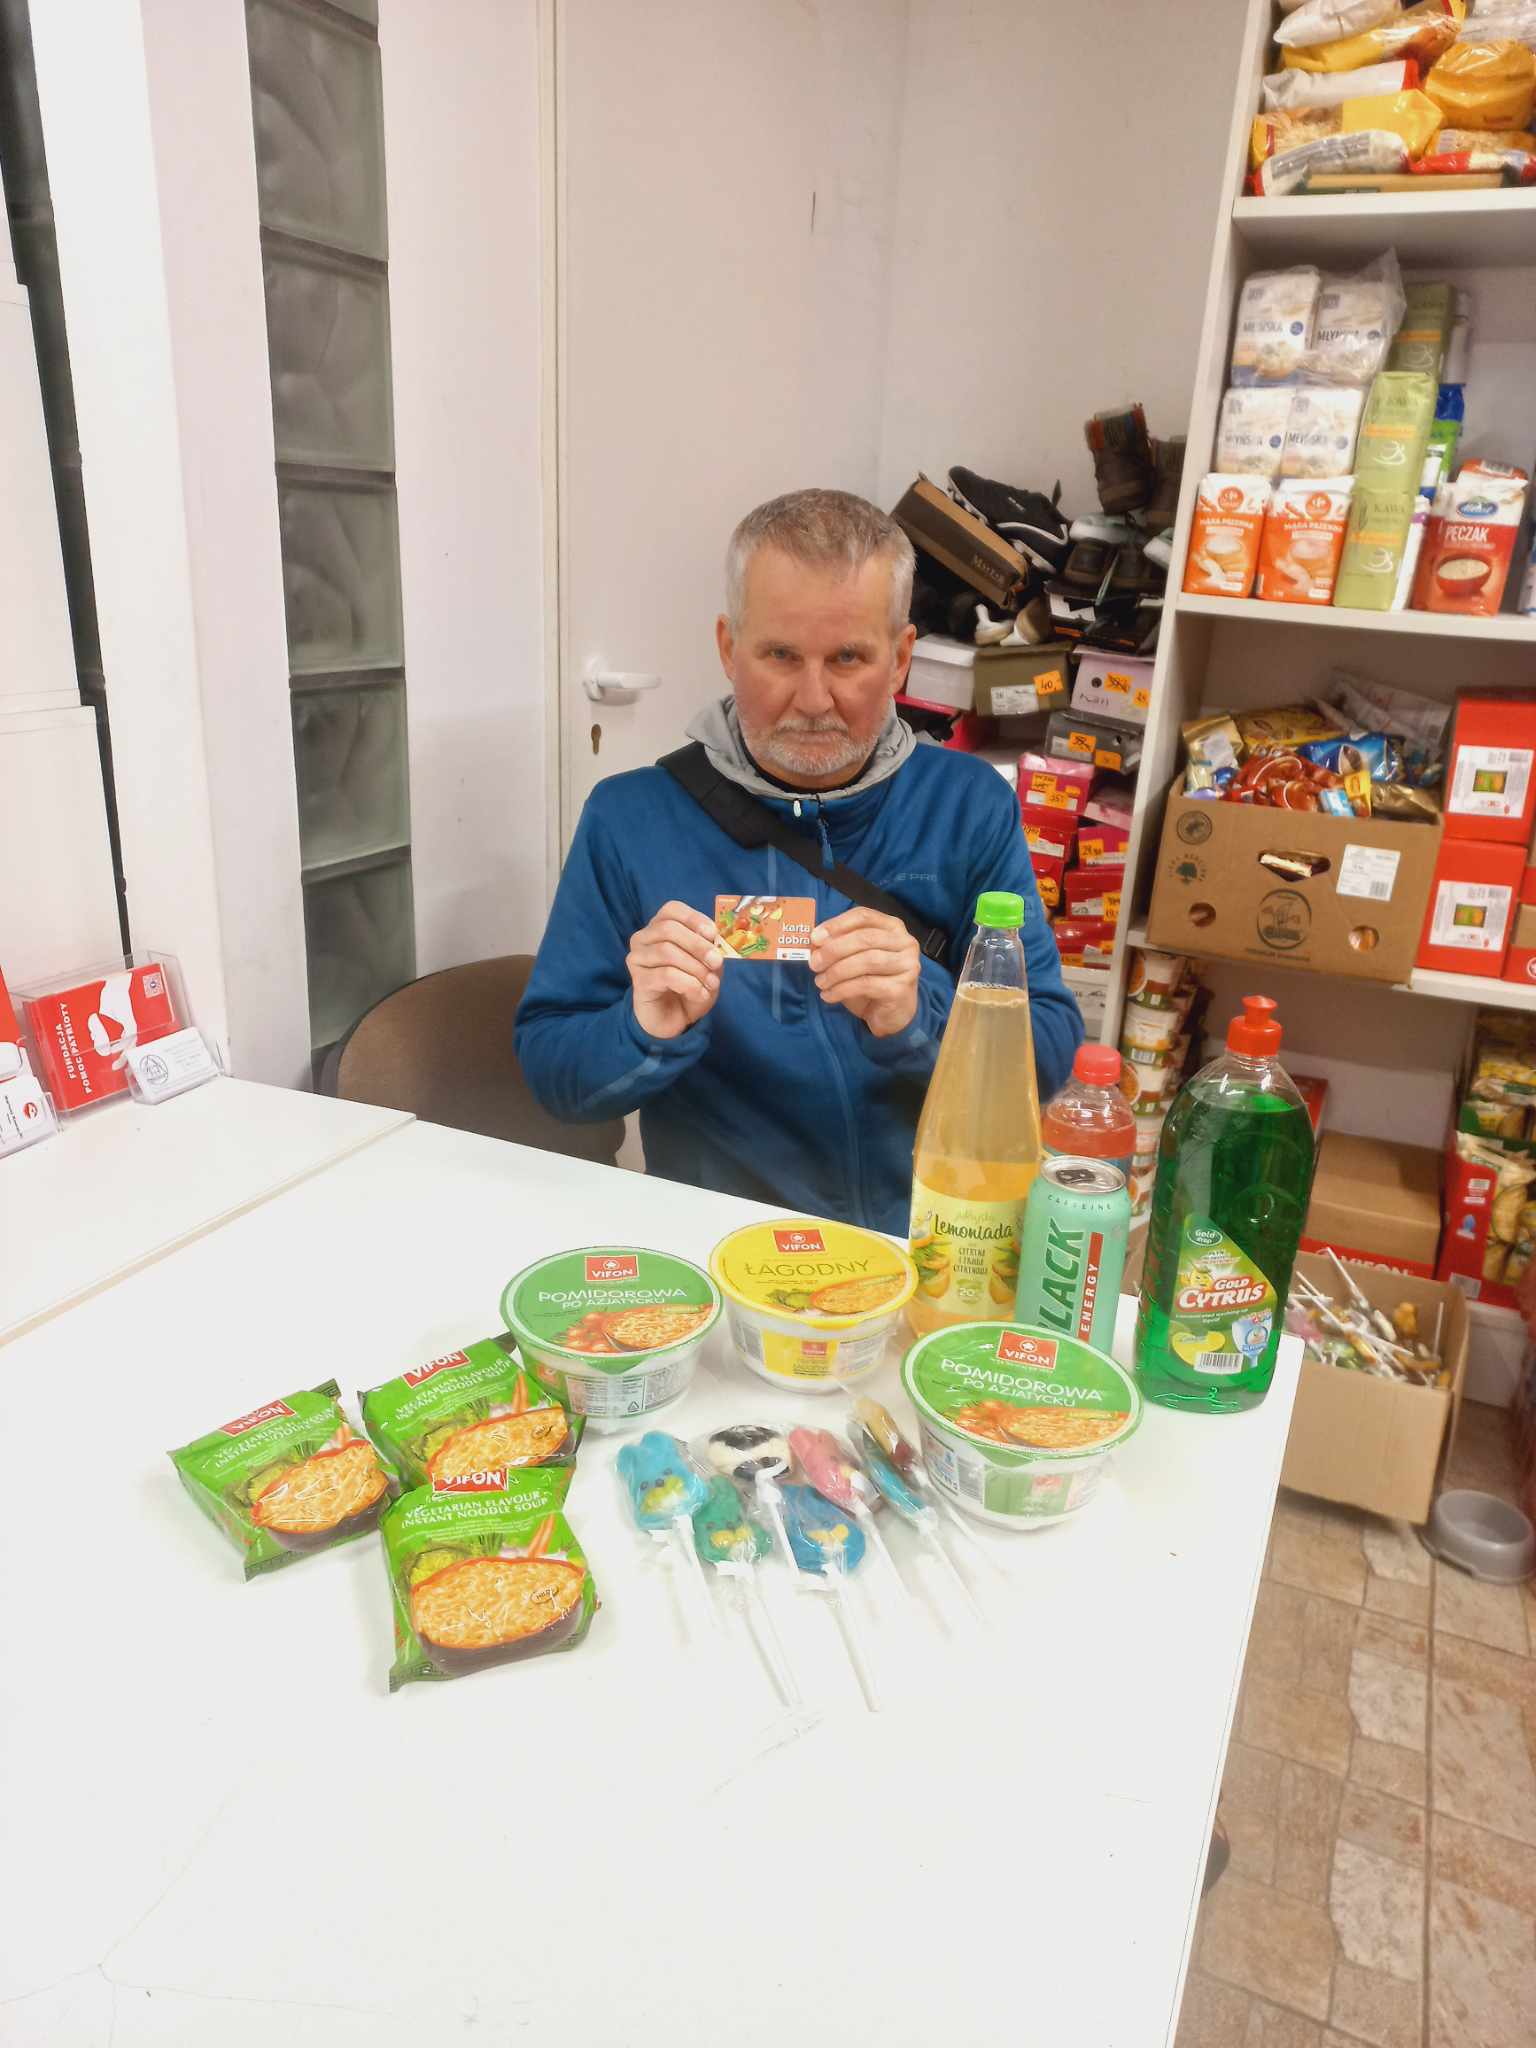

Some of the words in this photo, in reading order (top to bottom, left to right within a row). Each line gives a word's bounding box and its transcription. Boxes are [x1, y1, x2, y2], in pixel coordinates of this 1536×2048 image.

[778, 934, 811, 945] dobra
[783, 923, 811, 934] karta
[59, 1002, 79, 1056] PATRIOTY
[55, 1023, 77, 1080] FUNDACJA
[77, 1055, 93, 1094] POMOC
[934, 1214, 1014, 1240] Lemoniada
[1195, 1229, 1216, 1239] Gold
[781, 1241, 822, 1251] VIFON
[591, 1268, 634, 1278] VIFON
[745, 1260, 869, 1277] ŁAGODNY
[1037, 1218, 1086, 1338] LACK
[538, 1288, 687, 1303] POMIDOROWA
[1179, 1283, 1265, 1309] CYTRUS
[1215, 1279, 1250, 1290] GOLD
[562, 1299, 581, 1309] PO
[585, 1296, 666, 1307] AZJATYCKU
[1079, 1263, 1100, 1333] ENERGY
[410, 1351, 463, 1379] VIFON
[1004, 1348, 1052, 1366] VIFON
[941, 1358, 1103, 1402] POMIDOROWA
[963, 1377, 986, 1390] PO
[991, 1382, 1077, 1408] AZJATYCKU
[442, 1470, 502, 1486] VIFON
[401, 1514, 454, 1529] INSTANT
[457, 1506, 512, 1518] NOODLE
[515, 1497, 548, 1513] SOUP
[405, 1501, 481, 1518] VEGETARIAN
[485, 1492, 541, 1507] FLAVOUR
